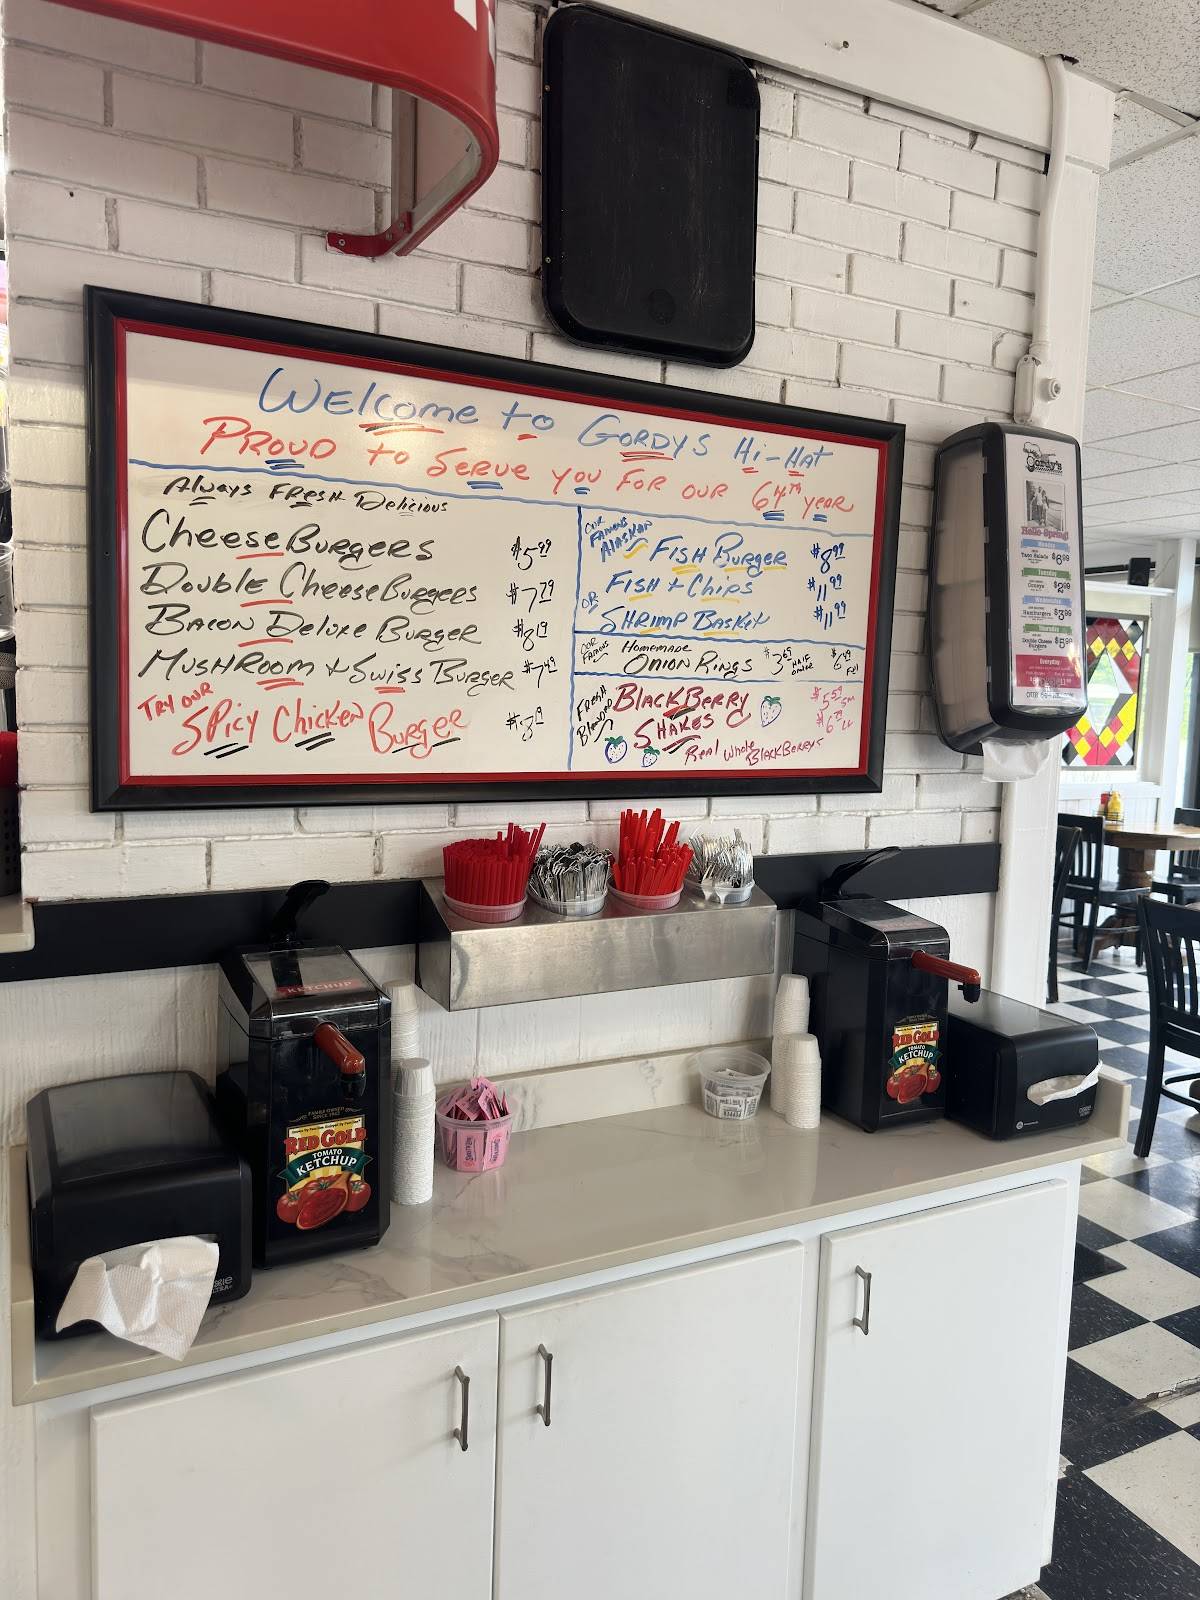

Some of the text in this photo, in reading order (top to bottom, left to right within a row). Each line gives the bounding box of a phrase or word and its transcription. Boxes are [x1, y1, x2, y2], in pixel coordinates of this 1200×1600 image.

[287, 981, 352, 994] KETCHUP
[898, 1050, 934, 1065] KETCHUP
[311, 1148, 343, 1159] TOMATO
[295, 1155, 358, 1178] KETCHUP
